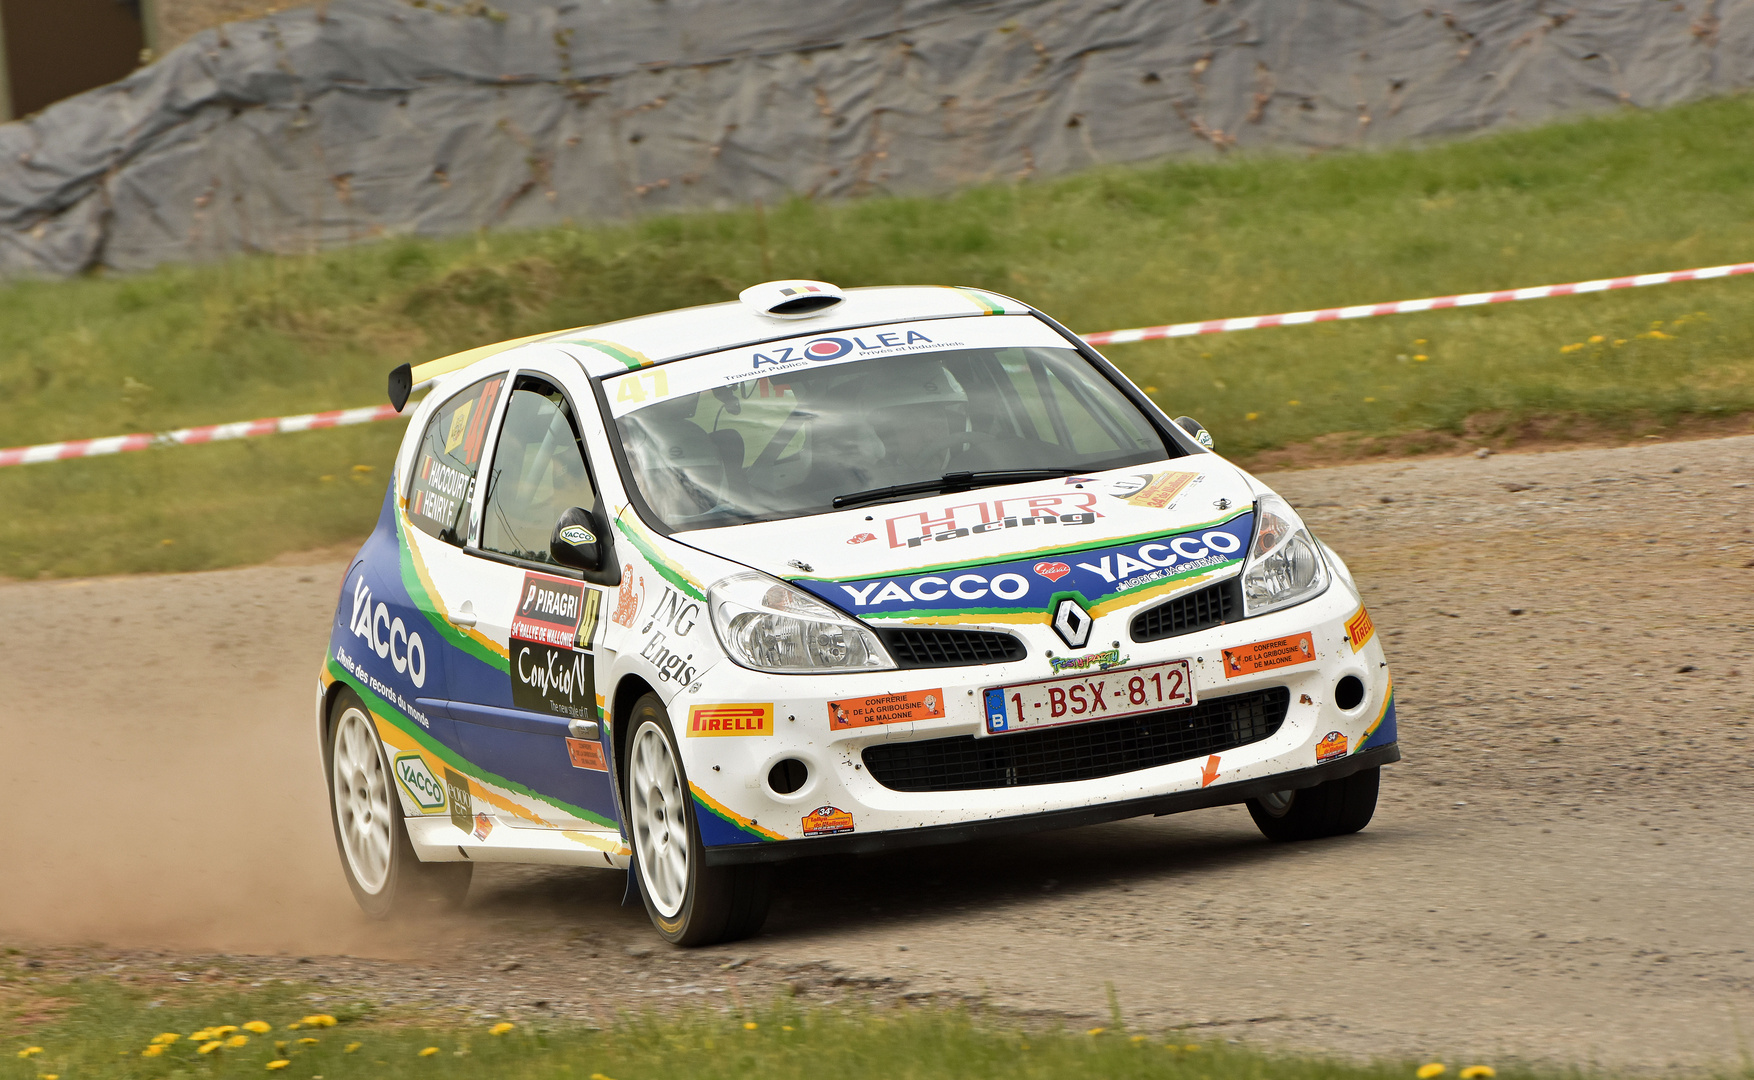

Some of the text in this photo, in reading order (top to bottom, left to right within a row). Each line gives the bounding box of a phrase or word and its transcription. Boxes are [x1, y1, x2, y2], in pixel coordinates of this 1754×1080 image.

[753, 330, 932, 369] AZOLEA
[908, 341, 965, 351] Industriels
[616, 369, 669, 403] 47
[723, 361, 808, 381] Travaux Publics
[464, 378, 501, 465] 47
[428, 461, 469, 500] HACCOURT
[422, 490, 450, 523] HENRY
[565, 531, 592, 541] YACCO
[907, 512, 1096, 548] racing
[1076, 531, 1241, 583] YACCO
[535, 588, 579, 619] PIRAGRI
[840, 573, 1029, 606] YACCO
[578, 588, 600, 648] 47
[651, 586, 700, 637] ING
[350, 575, 425, 688] YACCO
[520, 623, 539, 640] RALLYE
[539, 626, 547, 642] DE
[546, 628, 574, 648] WALLONIE
[640, 630, 697, 687] Engis
[1244, 645, 1299, 663] DE LA GRIBOUSINE
[1254, 655, 1292, 669] DE MALONNE
[355, 664, 369, 684] des
[369, 676, 397, 703] records
[397, 694, 407, 711] du
[407, 703, 430, 728] monde
[550, 700, 559, 712] The
[558, 704, 569, 714] new
[569, 704, 580, 718] style
[853, 701, 922, 716] DE LA GRIBOUSINE
[692, 708, 764, 732] PIRELLI
[876, 711, 912, 721] MALONNE
[992, 713, 1004, 728] B
[401, 761, 441, 803] YACCO
